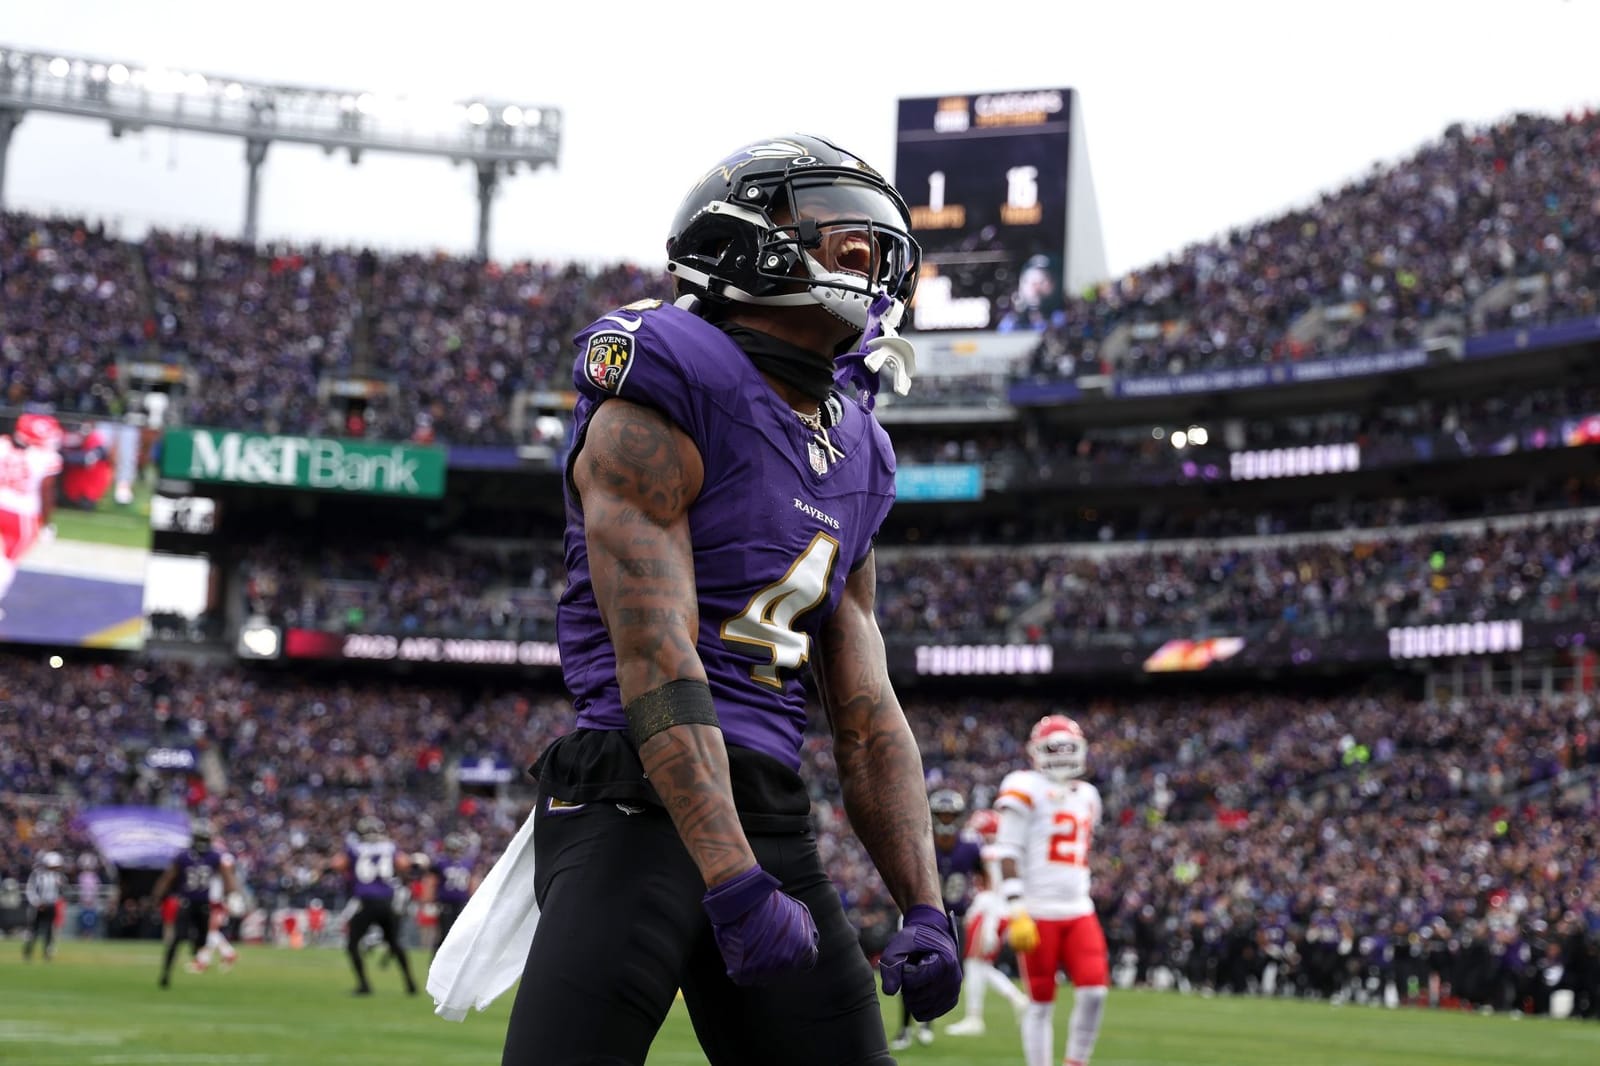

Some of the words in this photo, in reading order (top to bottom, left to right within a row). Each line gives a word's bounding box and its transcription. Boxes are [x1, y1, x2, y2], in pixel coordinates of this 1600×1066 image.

[592, 336, 628, 346] RAVENS
[190, 430, 305, 486] M&T
[308, 438, 420, 494] Bank
[793, 497, 840, 530] RAVENS
[719, 530, 841, 690] 4
